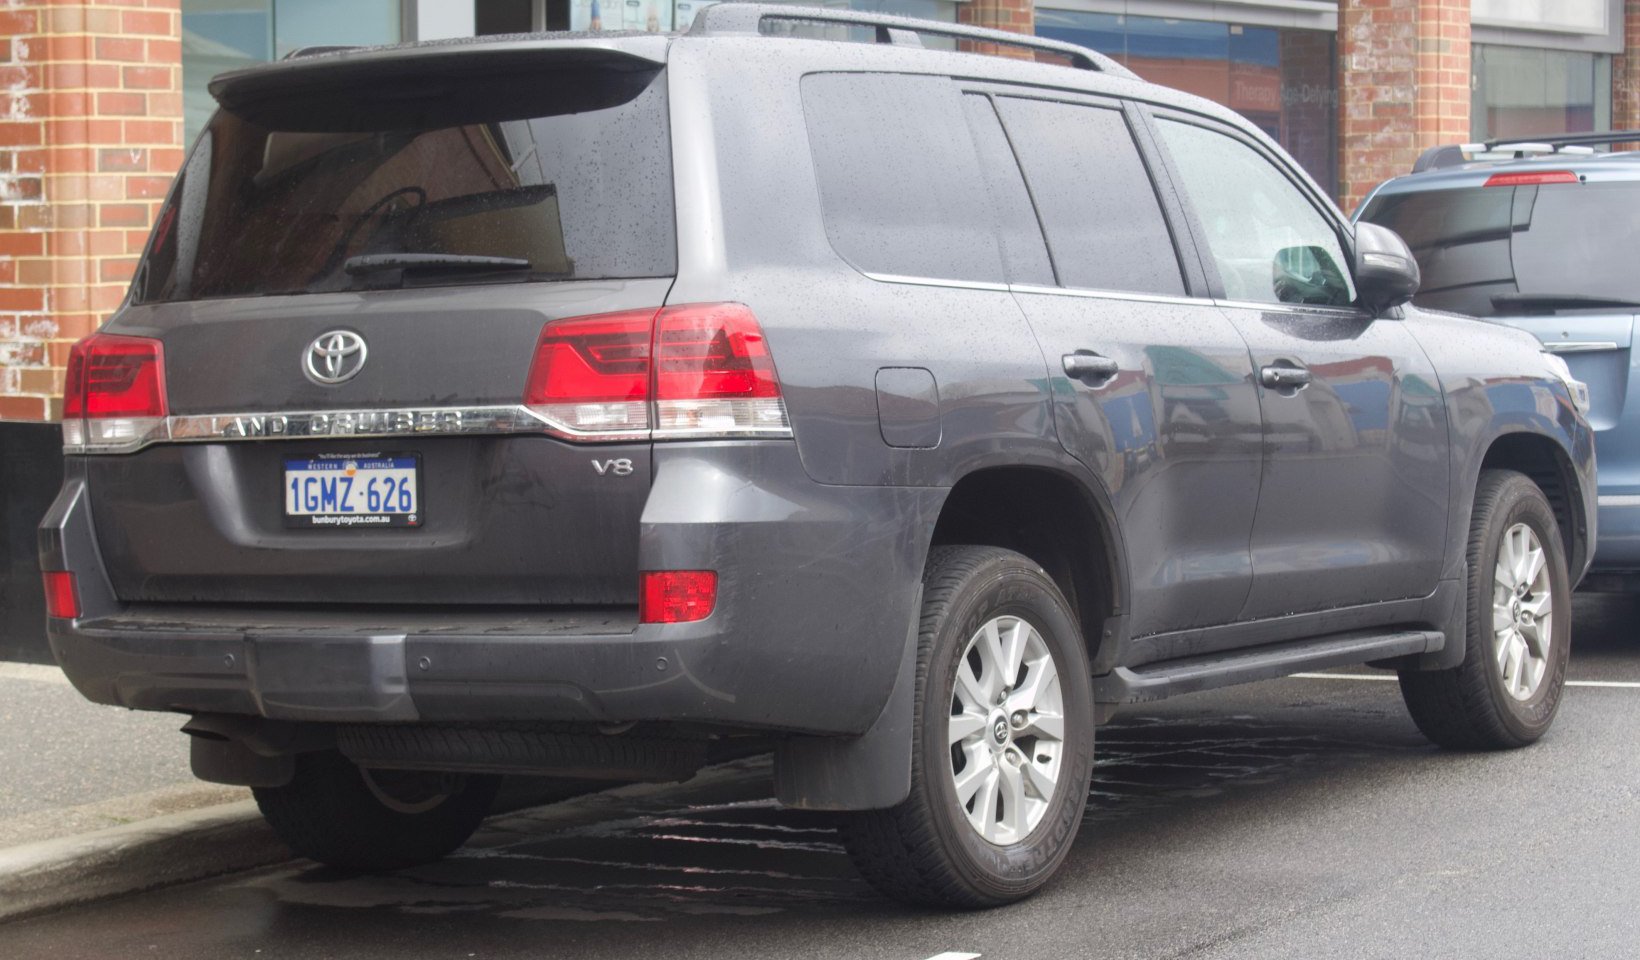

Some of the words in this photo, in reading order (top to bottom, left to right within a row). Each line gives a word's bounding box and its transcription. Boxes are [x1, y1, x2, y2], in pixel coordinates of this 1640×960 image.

[1235, 80, 1277, 107] Therapy
[211, 415, 288, 437] LAND
[310, 410, 463, 436] CRUISER
[591, 458, 633, 475] V8
[312, 515, 391, 525] bunburytoyota.com.au
